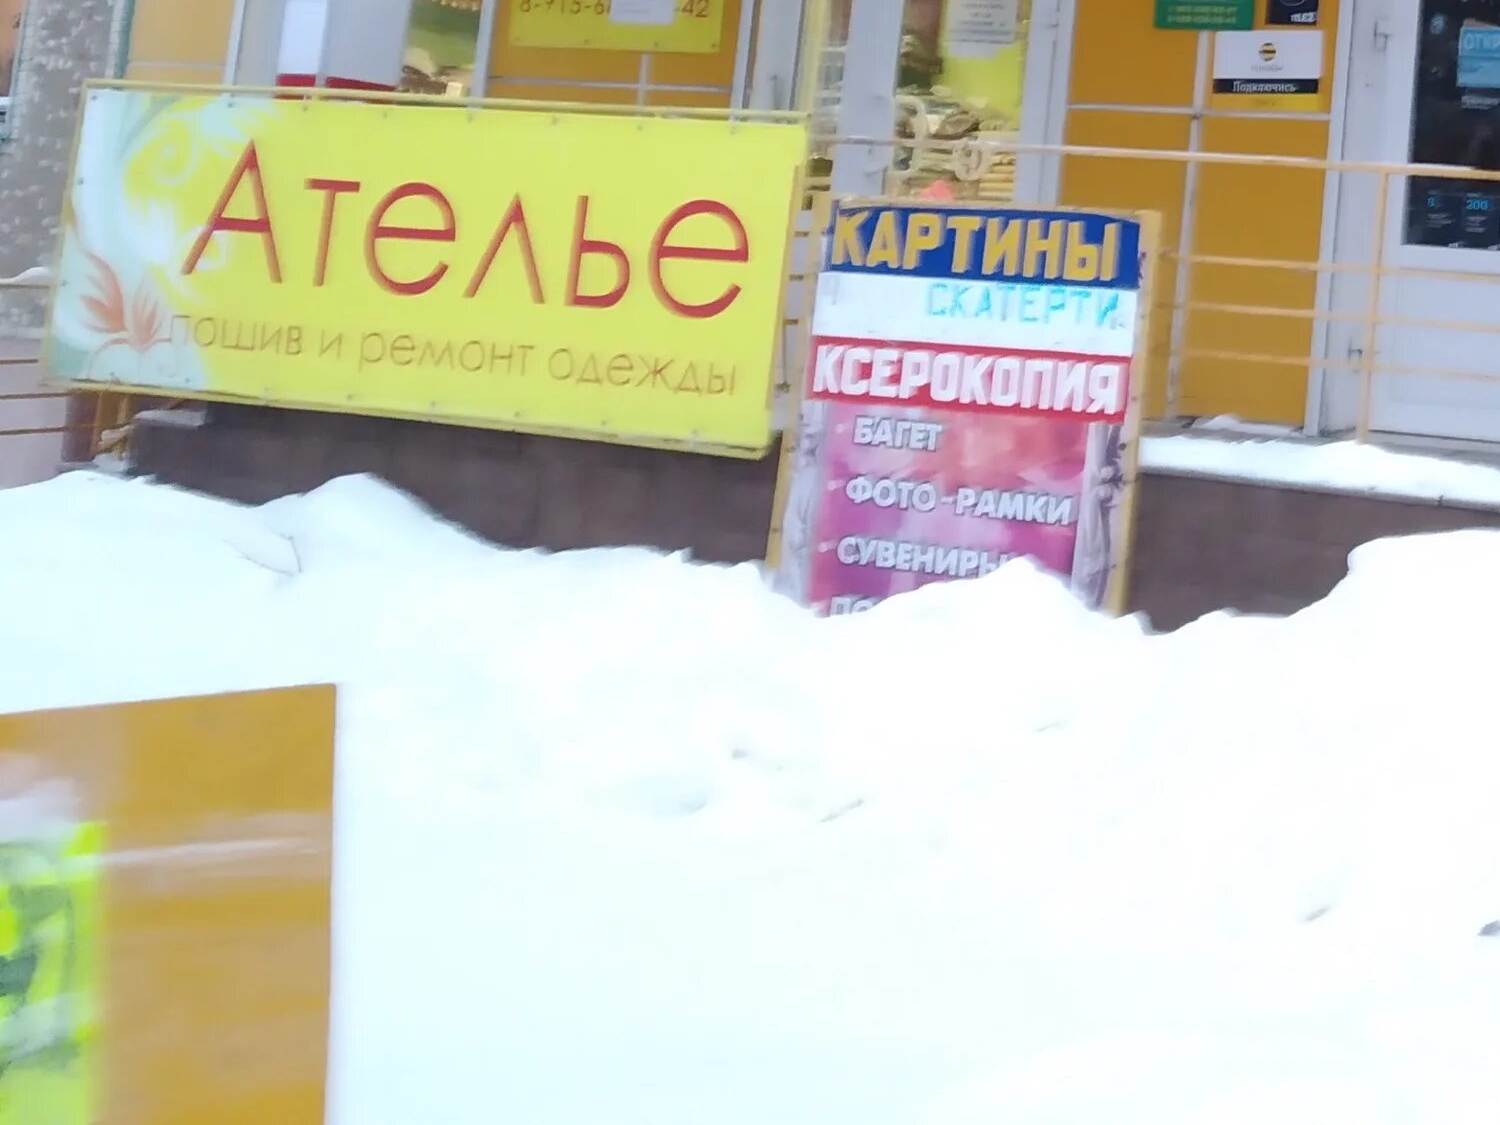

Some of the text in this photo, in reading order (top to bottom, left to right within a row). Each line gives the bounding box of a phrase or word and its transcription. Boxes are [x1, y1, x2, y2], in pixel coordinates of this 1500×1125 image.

[182, 138, 750, 318] Ателье
[832, 211, 1122, 283] КАРТИНЫ
[171, 313, 738, 397] пошив и ремонт одежды
[813, 343, 1124, 416] КСЕРОКОПИЯ
[853, 415, 943, 452] БАГЕТ
